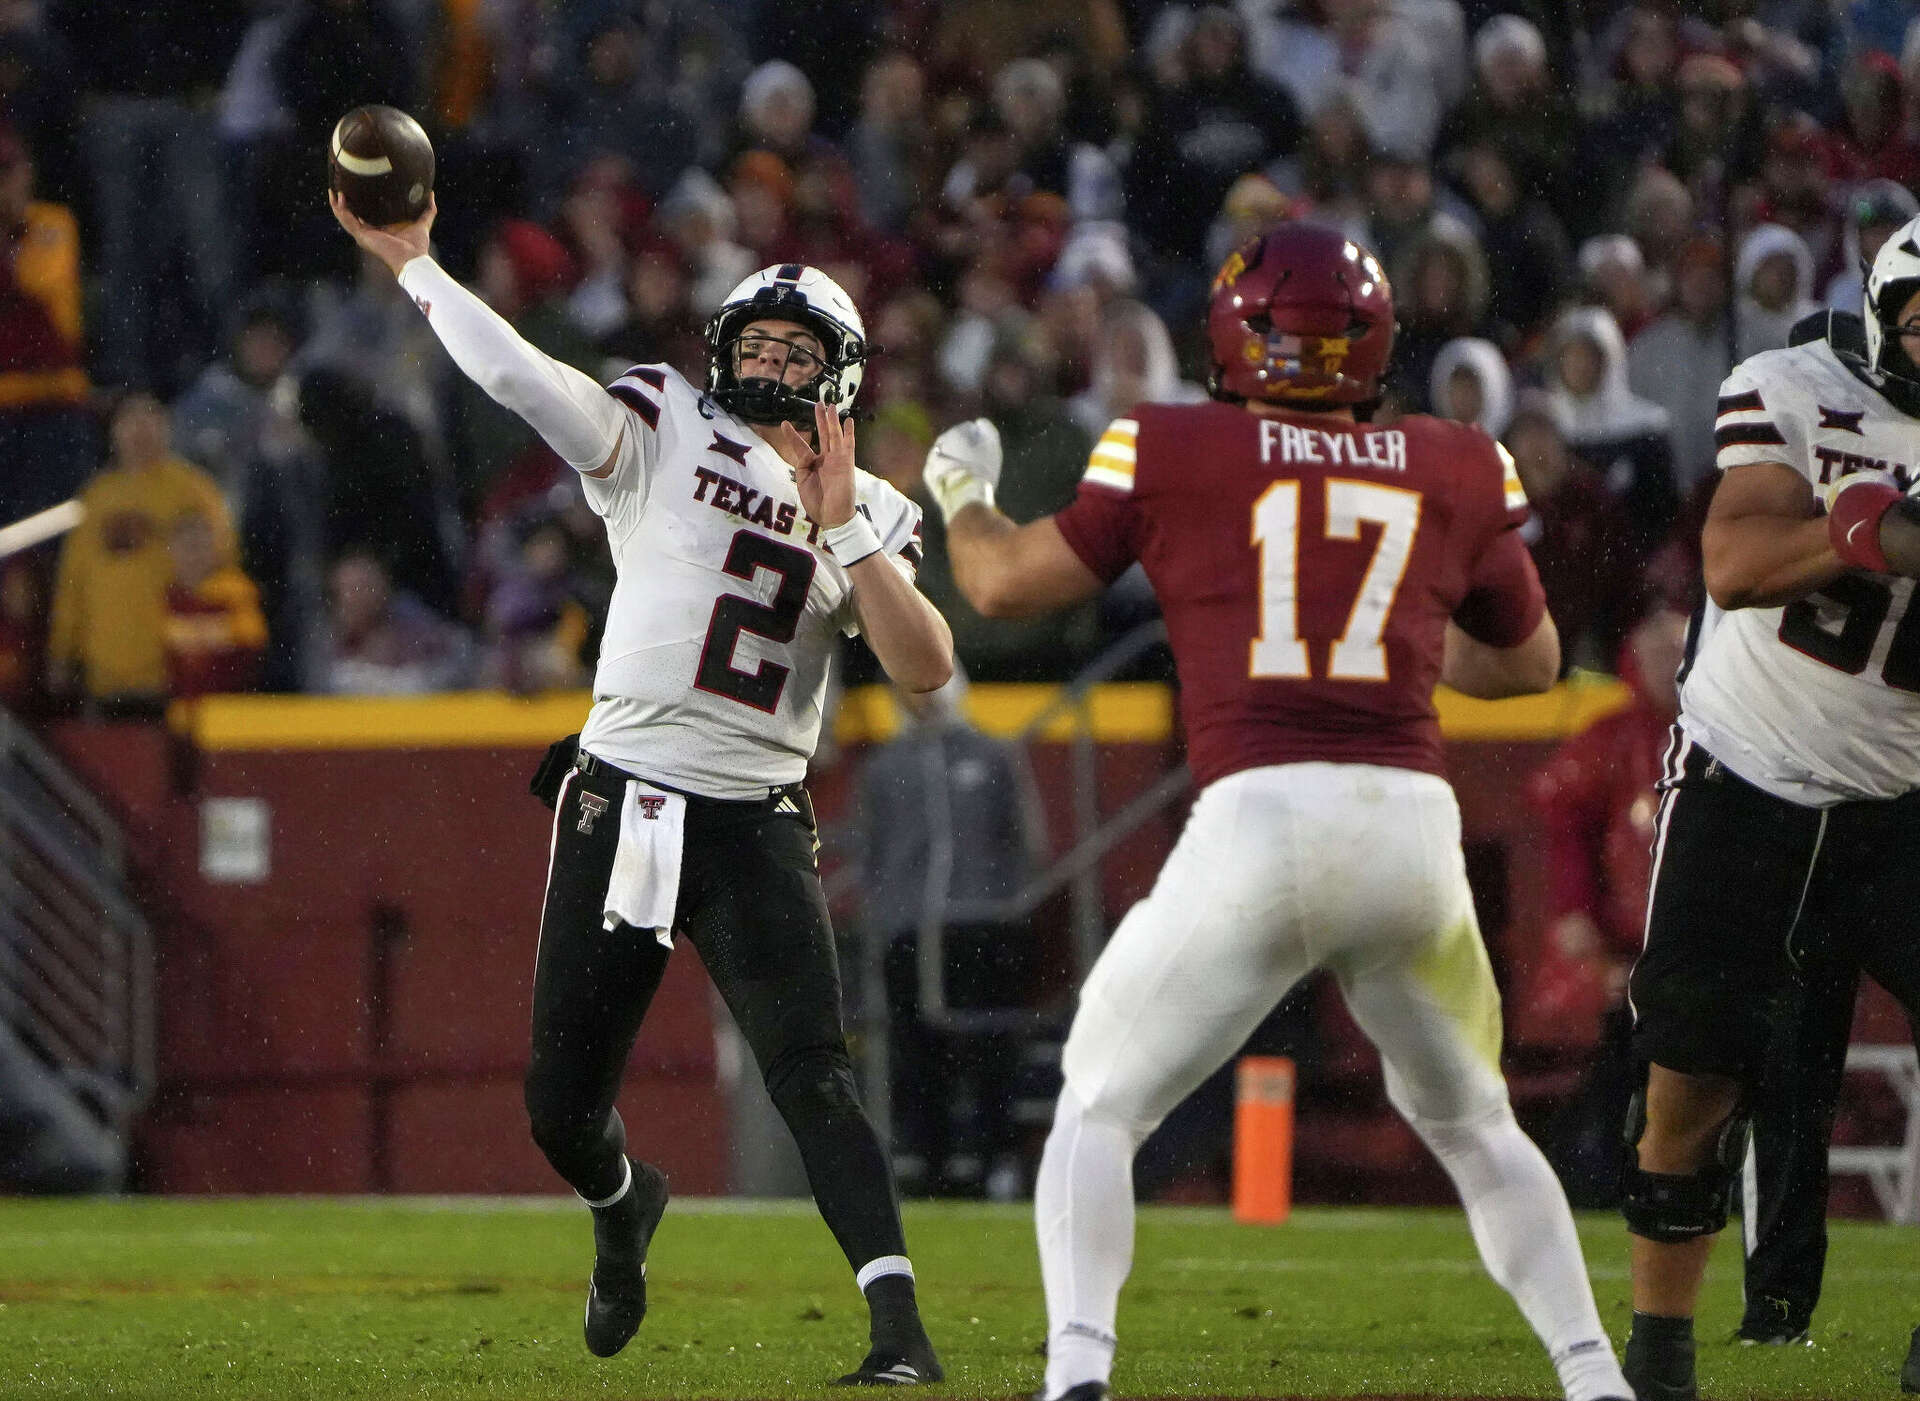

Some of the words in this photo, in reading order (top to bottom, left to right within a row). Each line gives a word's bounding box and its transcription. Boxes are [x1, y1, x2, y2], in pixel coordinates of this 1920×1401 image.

[693, 465, 798, 535] TEXAS
[1259, 419, 1407, 471] FREYLER
[694, 529, 818, 715] 2
[1249, 477, 1423, 682] 17
